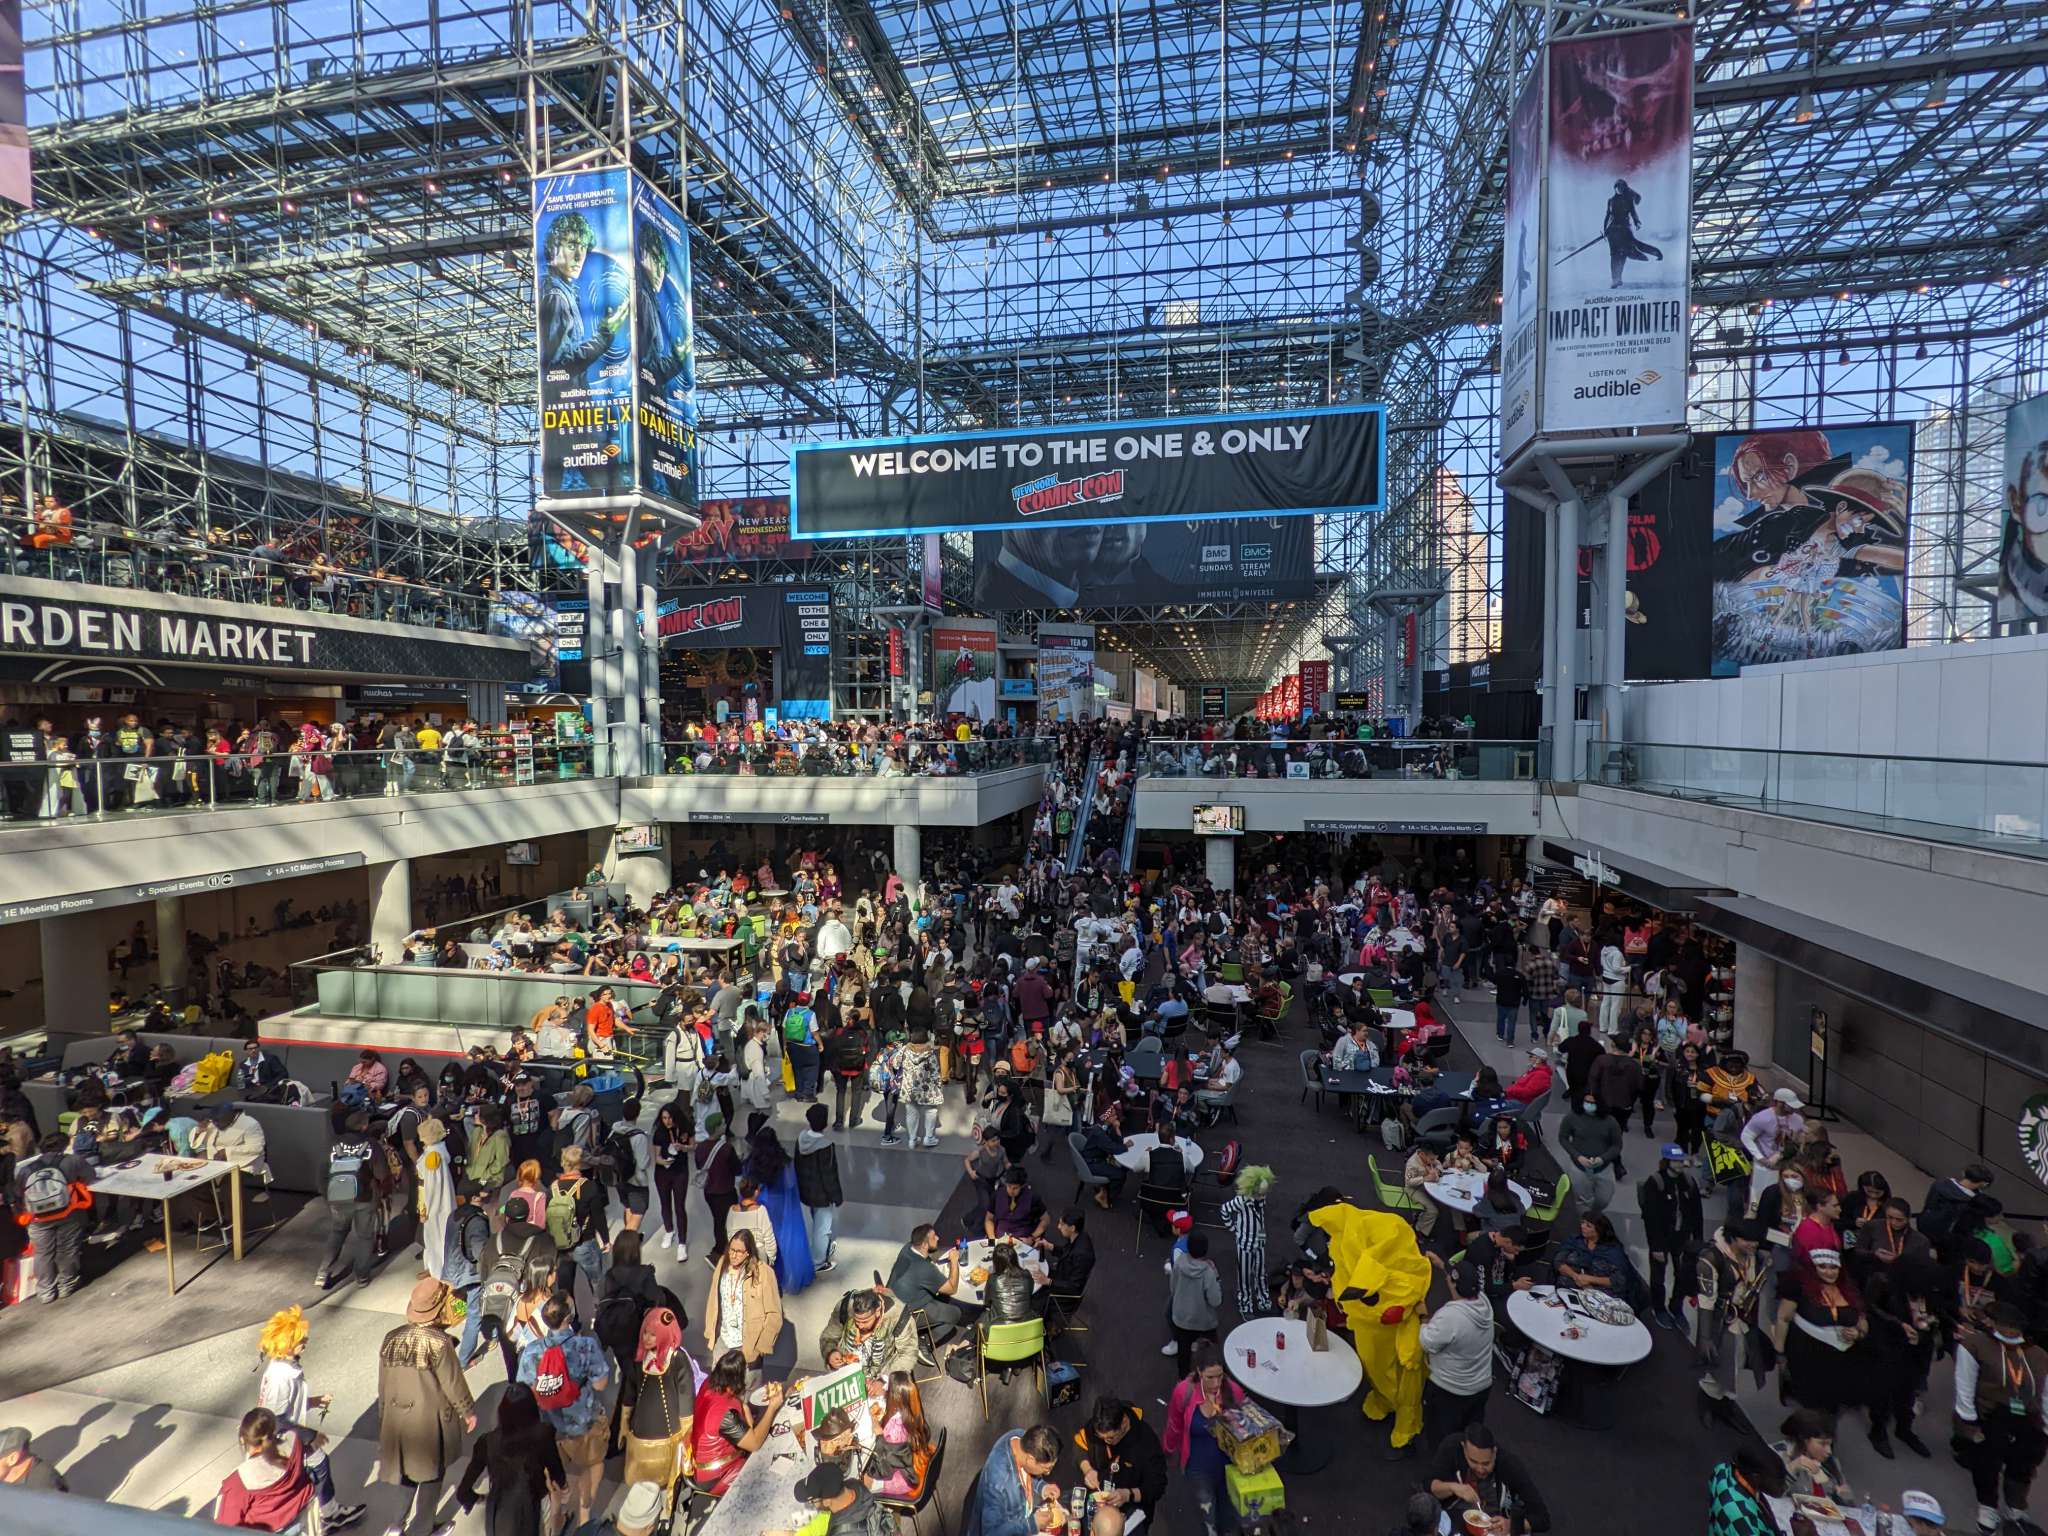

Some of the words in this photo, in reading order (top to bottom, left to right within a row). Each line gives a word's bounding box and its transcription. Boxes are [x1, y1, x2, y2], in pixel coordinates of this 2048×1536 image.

[565, 193, 582, 202] YOUR
[546, 202, 574, 212] SURVIVE
[574, 200, 590, 209] HIGH
[1584, 295, 1613, 305] audible
[1549, 306, 1610, 342] IMPACT
[1616, 300, 1680, 337] WINTER
[1628, 338, 1654, 346] WALKING
[1614, 347, 1636, 356] PACIFIC
[1589, 370, 1614, 378] LISTEN
[1615, 368, 1627, 376] ON
[560, 388, 586, 398] audible
[1574, 380, 1641, 400] audible
[546, 402, 576, 411] JAMES
[579, 397, 631, 408] PATTERSON
[544, 407, 616, 429] DANIEL
[620, 405, 632, 423] X
[559, 423, 619, 435] GENESIS
[640, 407, 686, 446] DANIEL
[687, 430, 696, 449] X
[572, 443, 590, 451] LISTEN
[849, 446, 997, 478] WELCOME
[1002, 442, 1043, 468] TO
[1048, 438, 1107, 465] THE
[1114, 433, 1183, 461] ONE
[1191, 430, 1215, 456] &
[1221, 424, 1311, 454] ONLY
[562, 451, 609, 468] audible
[652, 459, 683, 480] audible
[1013, 482, 1033, 498] NEW
[1033, 474, 1058, 492] YORK
[1018, 480, 1080, 513] COMIC
[1082, 471, 1121, 500] CON
[738, 518, 760, 526] NEW
[740, 526, 786, 534] WEDNESDAYS
[1200, 564, 1233, 572] SUNDAYS
[1198, 591, 1231, 599] IMMORTAL
[1240, 588, 1274, 596] UNIVERSE
[703, 598, 740, 630] CON
[160, 616, 316, 663] MARKET
[806, 632, 826, 640] ONLY
[1304, 666, 1313, 706] JAVITS
[300, 862, 324, 870] Meeting
[148, 884, 178, 896] Special
[179, 880, 206, 890] Events
[4, 908, 17, 918] 1E
[20, 902, 60, 916] Meeting
[61, 898, 94, 909] Rooms
[818, 1376, 860, 1414] PIZZA
